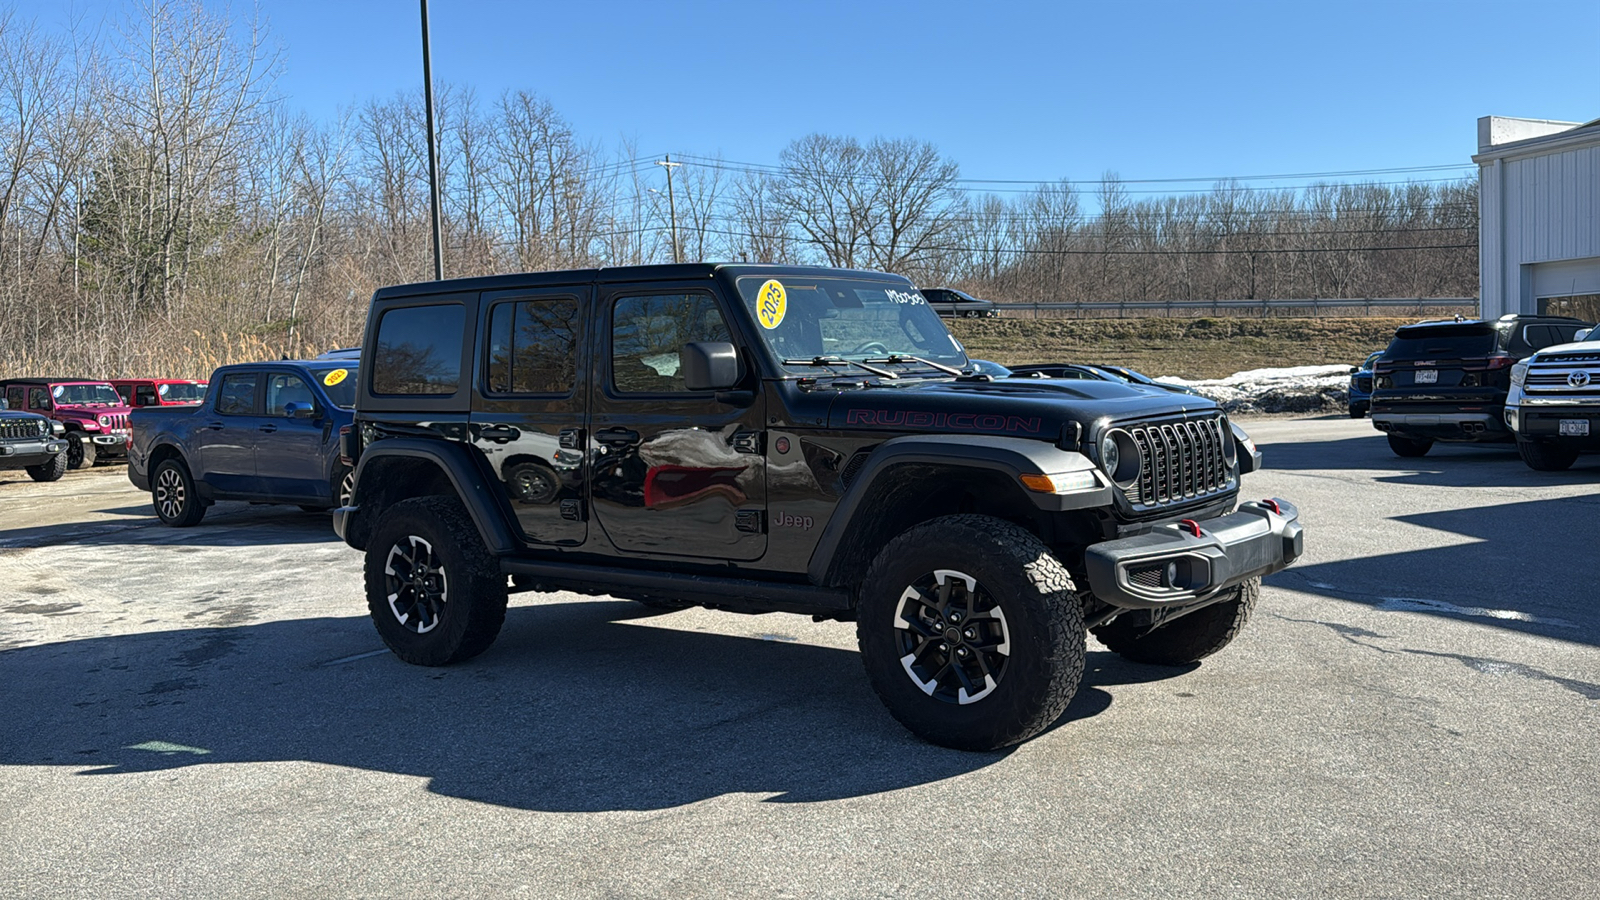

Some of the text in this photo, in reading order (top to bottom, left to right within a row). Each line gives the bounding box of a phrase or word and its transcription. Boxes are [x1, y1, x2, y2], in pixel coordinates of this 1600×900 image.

[761, 282, 782, 325] 2025
[846, 408, 1042, 433] RUBICON
[773, 510, 815, 531] Jeep
